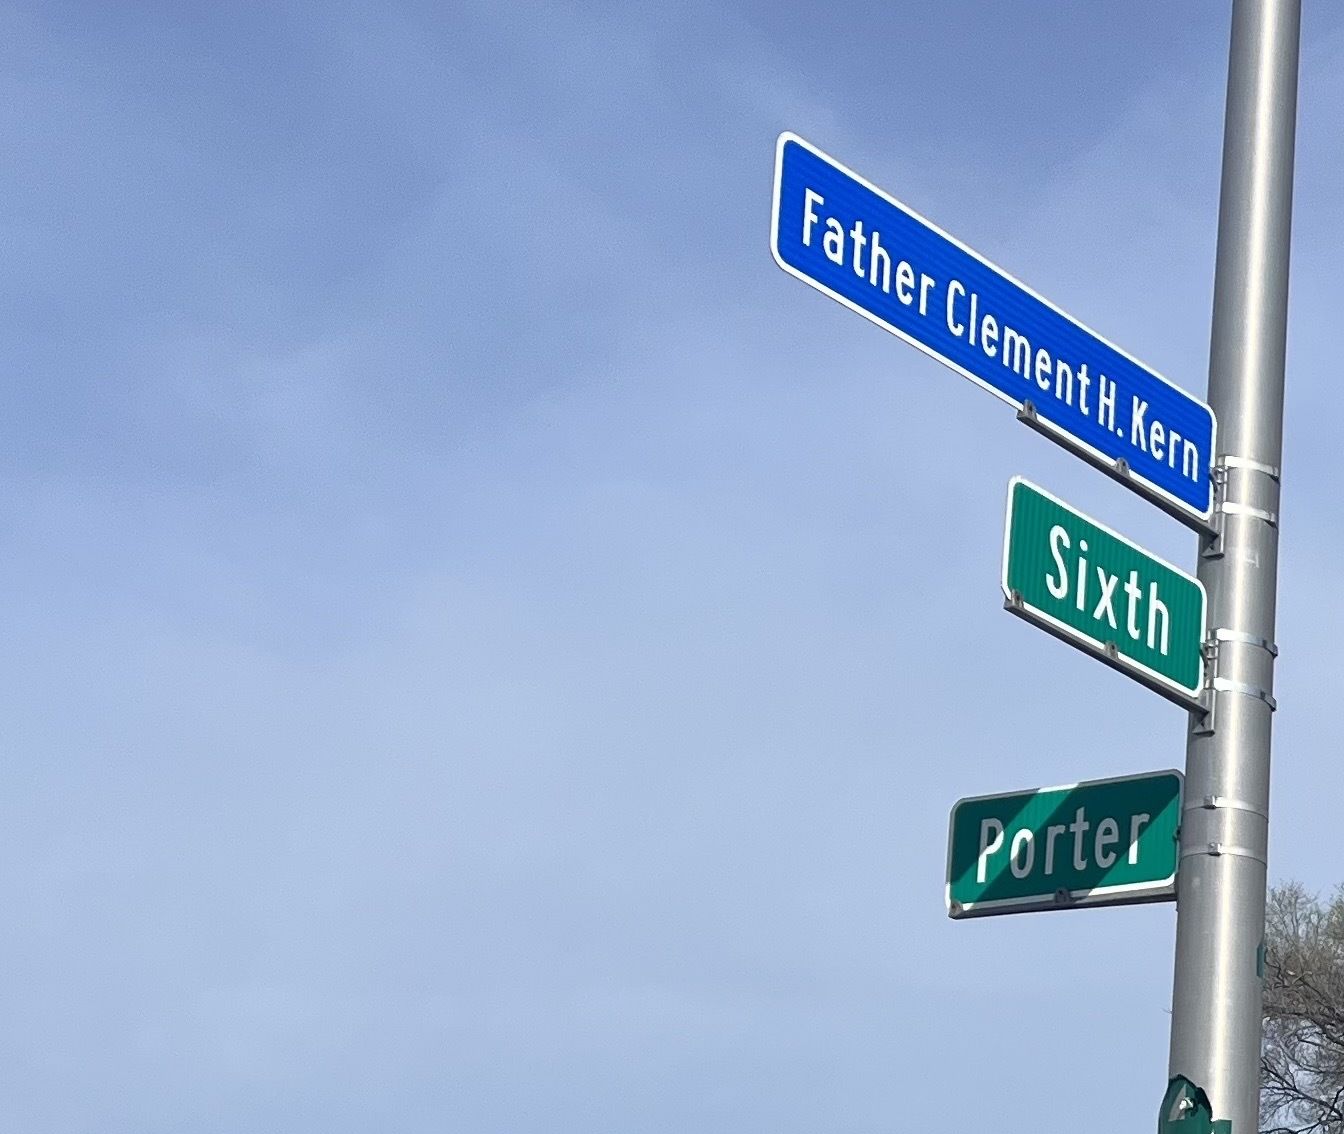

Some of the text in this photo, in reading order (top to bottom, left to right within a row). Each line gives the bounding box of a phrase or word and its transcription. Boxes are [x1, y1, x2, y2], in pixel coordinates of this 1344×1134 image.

[802, 187, 1199, 483] Father Clement H. Kern
[1045, 525, 1169, 656] Sixth
[976, 807, 1150, 884] Porter
